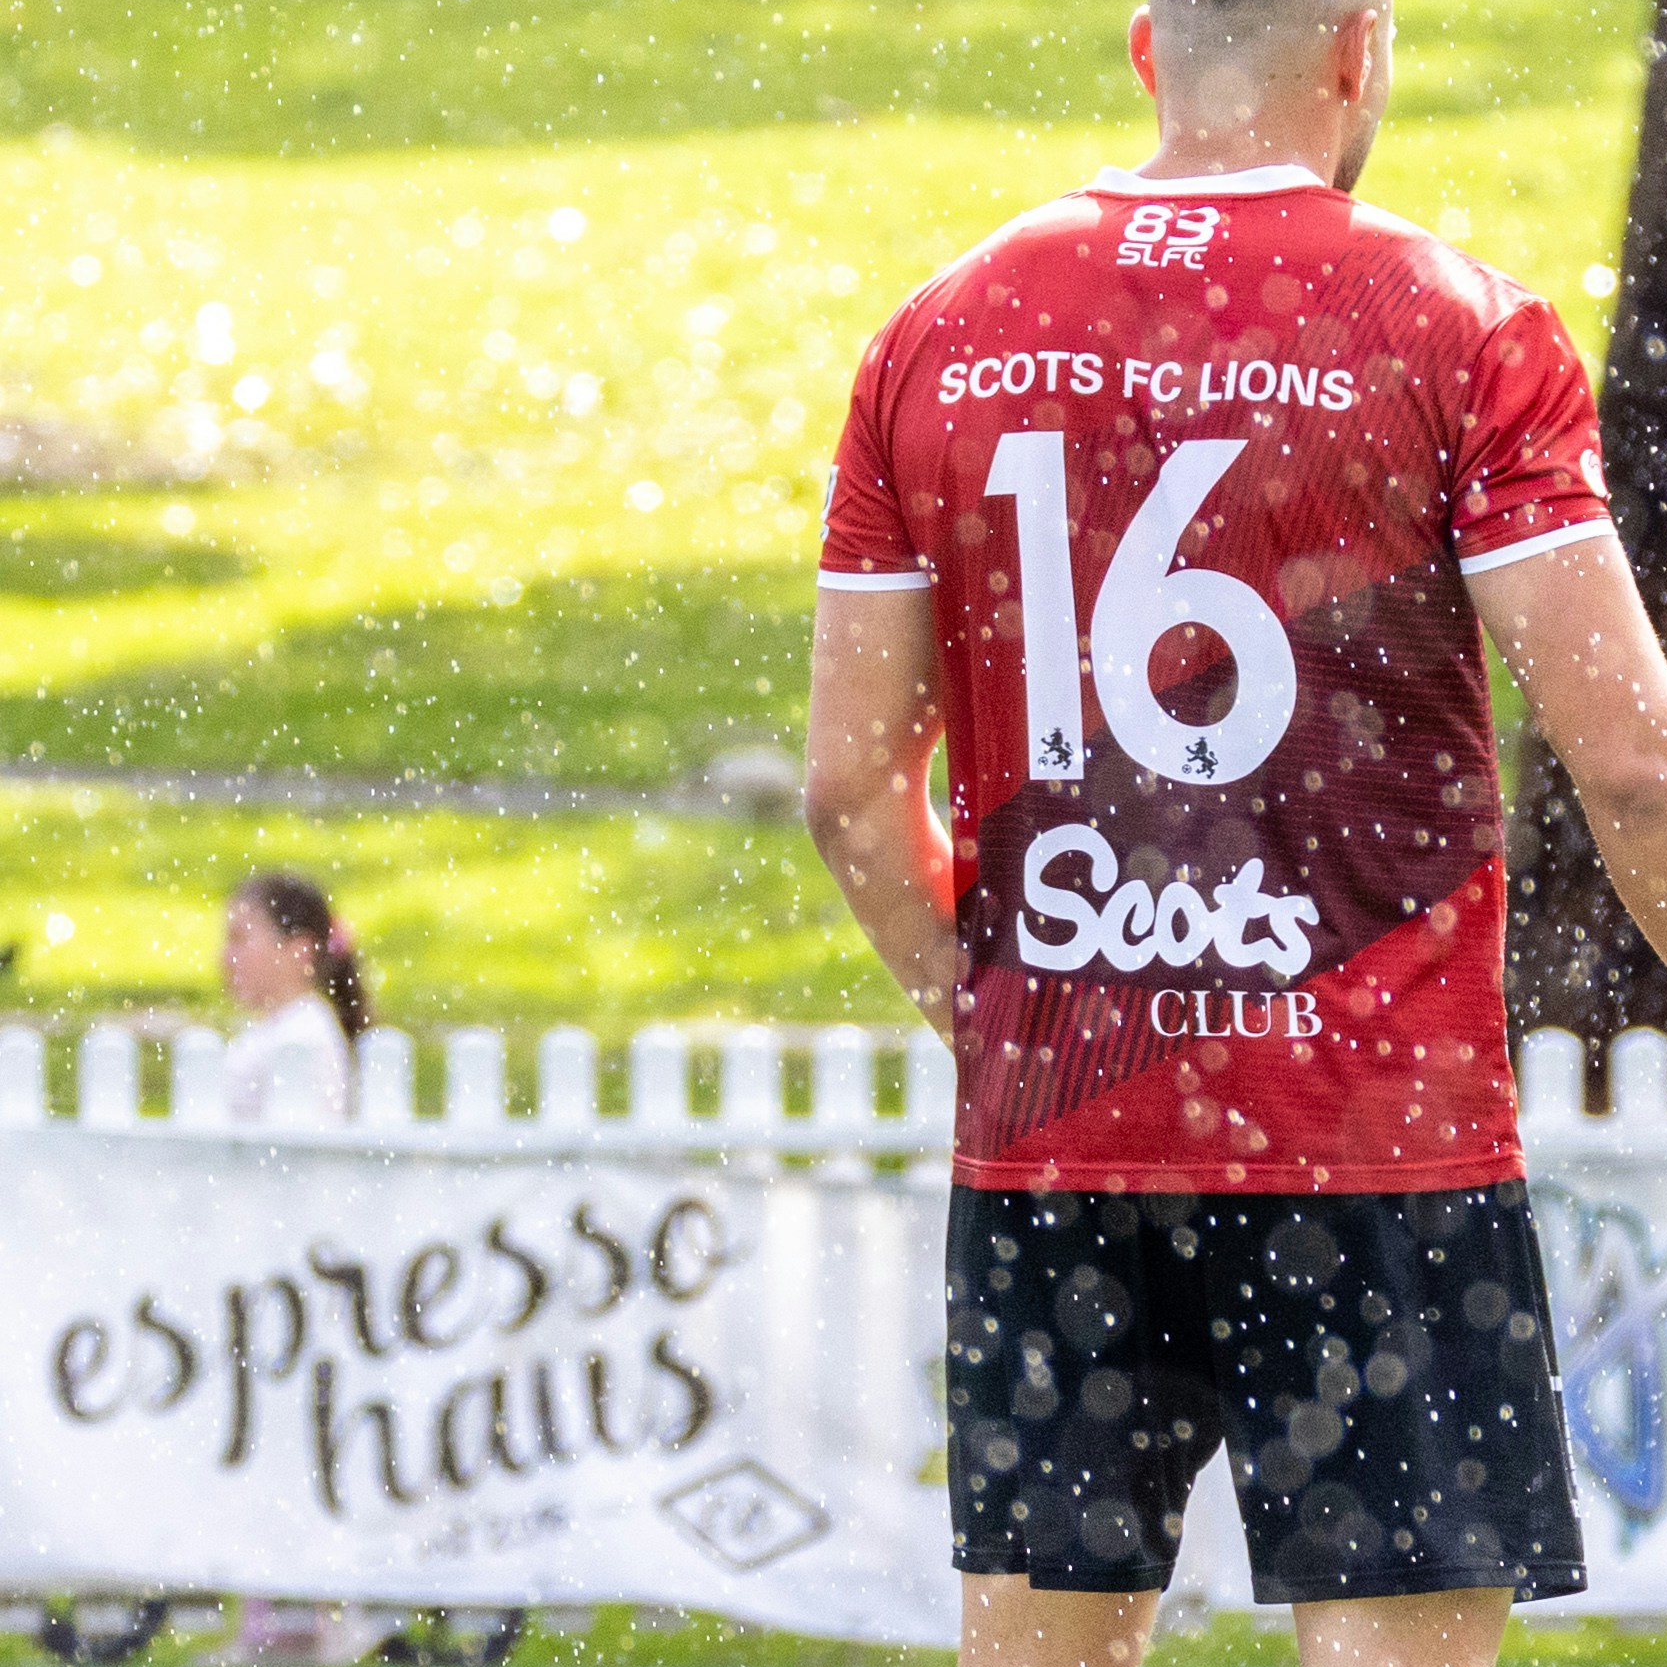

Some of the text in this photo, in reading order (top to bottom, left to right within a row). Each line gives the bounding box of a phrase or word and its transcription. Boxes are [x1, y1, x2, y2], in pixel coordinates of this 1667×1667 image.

[1116, 242, 1208, 270] SLFC
[1124, 204, 1221, 245] 83
[938, 350, 1355, 411] SCOTS FC LIONS
[984, 431, 1297, 784] 16
[1017, 823, 1319, 976] Scots
[1150, 989, 1323, 1038] CLUB
[53, 1195, 735, 1471] espresso
[310, 1331, 714, 1514] haus
